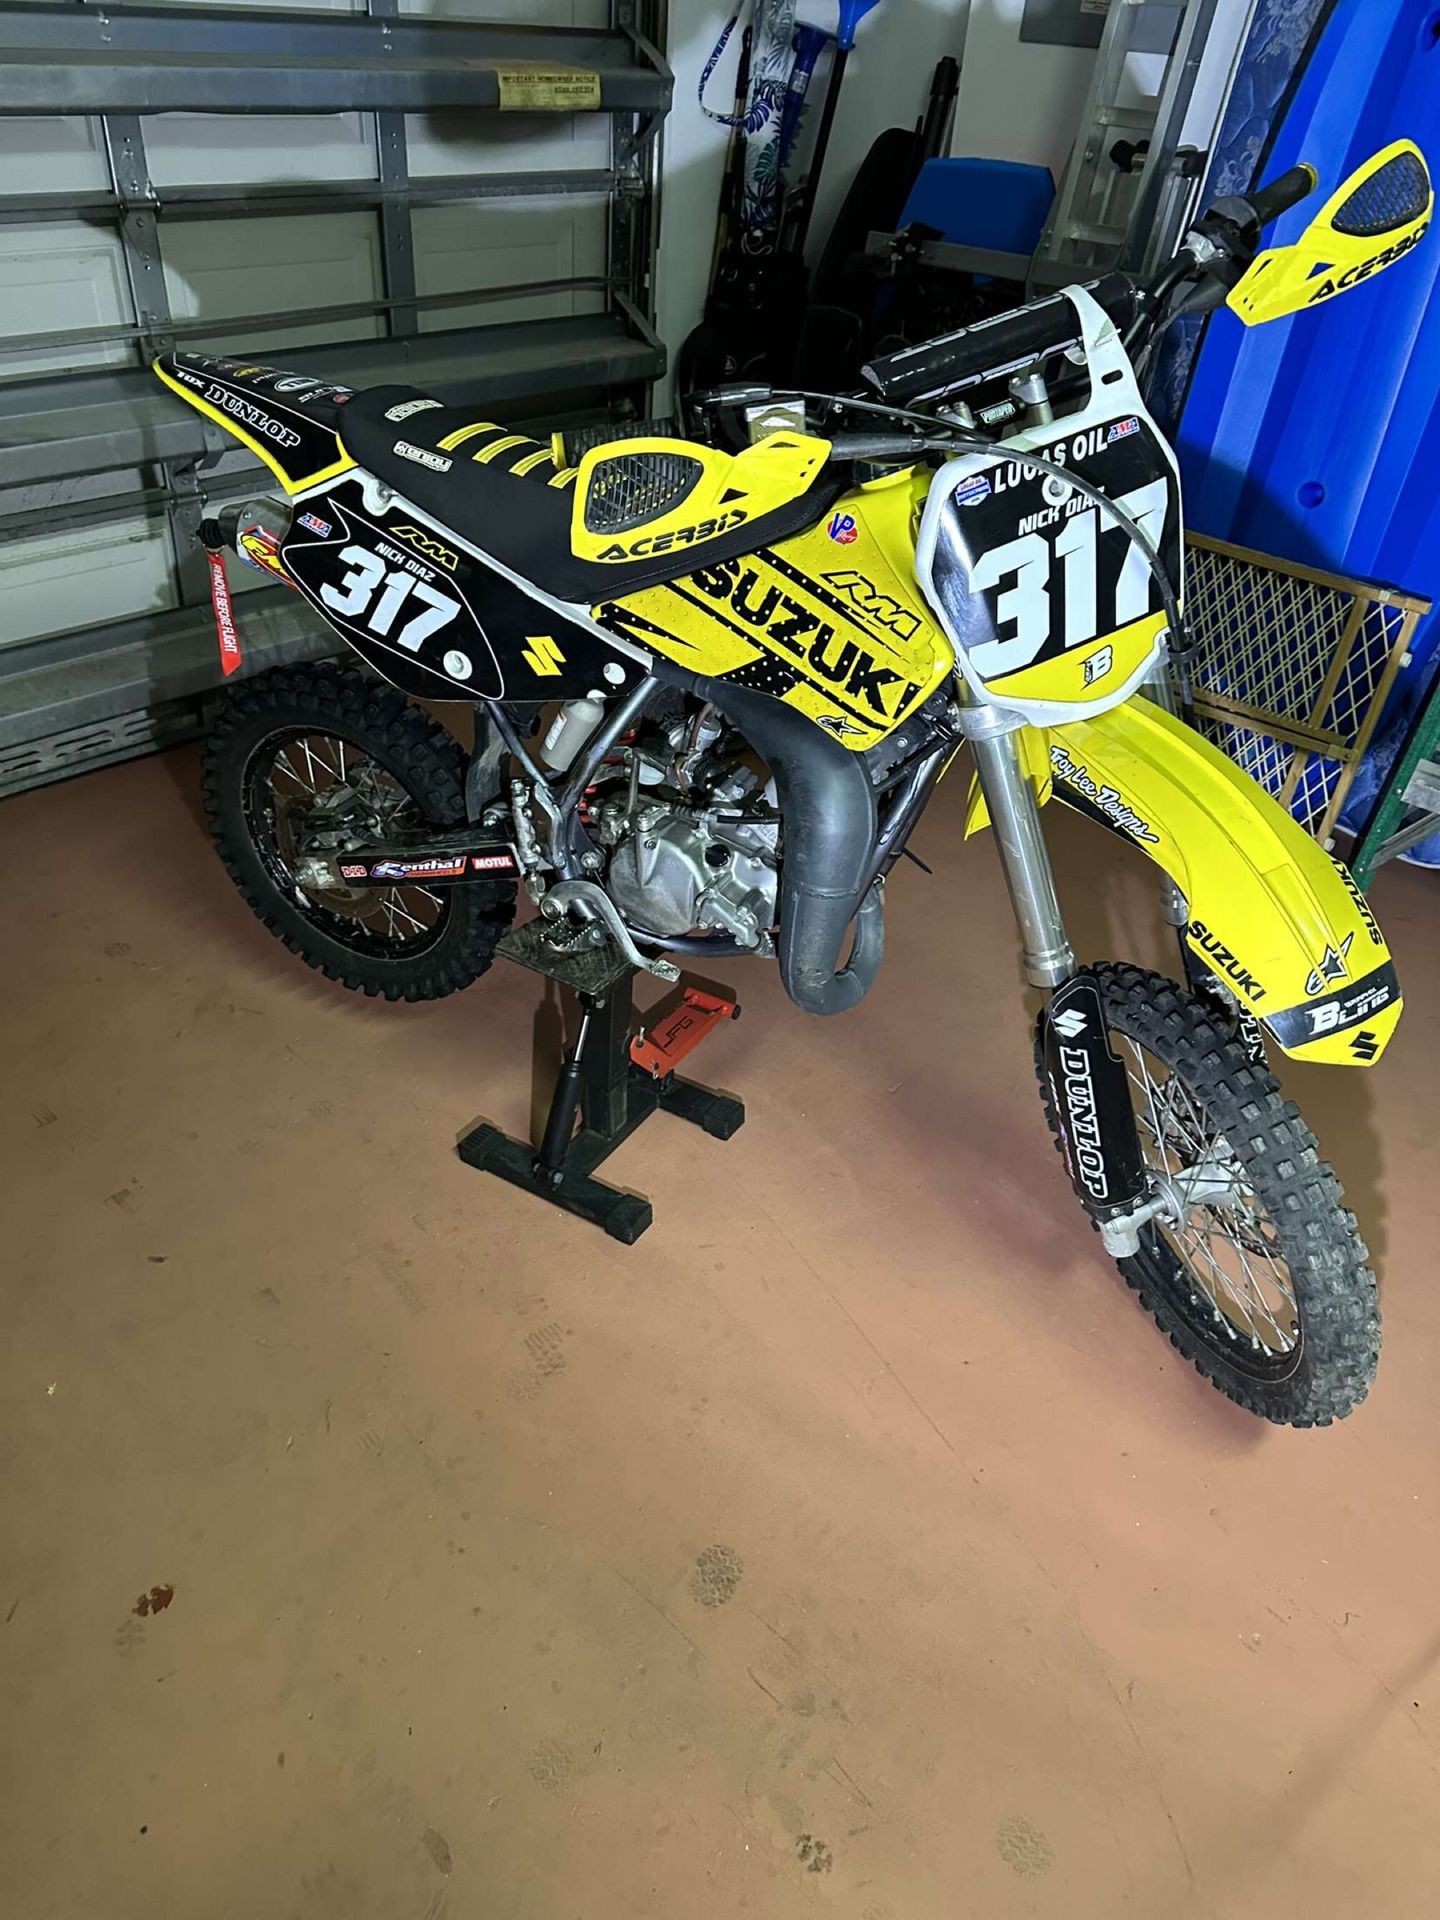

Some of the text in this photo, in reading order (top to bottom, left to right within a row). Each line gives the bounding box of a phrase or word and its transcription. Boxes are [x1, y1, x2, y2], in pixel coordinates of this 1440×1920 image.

[204, 383, 301, 448] DUNLOP
[1072, 427, 1108, 461] OIL
[374, 541, 436, 582] NICK DIAZ
[597, 509, 749, 561] ACERBIS
[1018, 506, 1061, 537] NICK
[212, 563, 238, 654] REMOVE BEFORE FLIGHT
[320, 544, 462, 653] 317
[967, 476, 1169, 679] 317
[691, 557, 923, 720] SUZUKI
[1049, 745, 1161, 843] Troy Lee Designs
[474, 857, 513, 870] MOTUL
[1331, 860, 1383, 946] SUZUKI
[1187, 920, 1267, 1002] SUZUKI
[1059, 1045, 1109, 1199] DUNLOP
